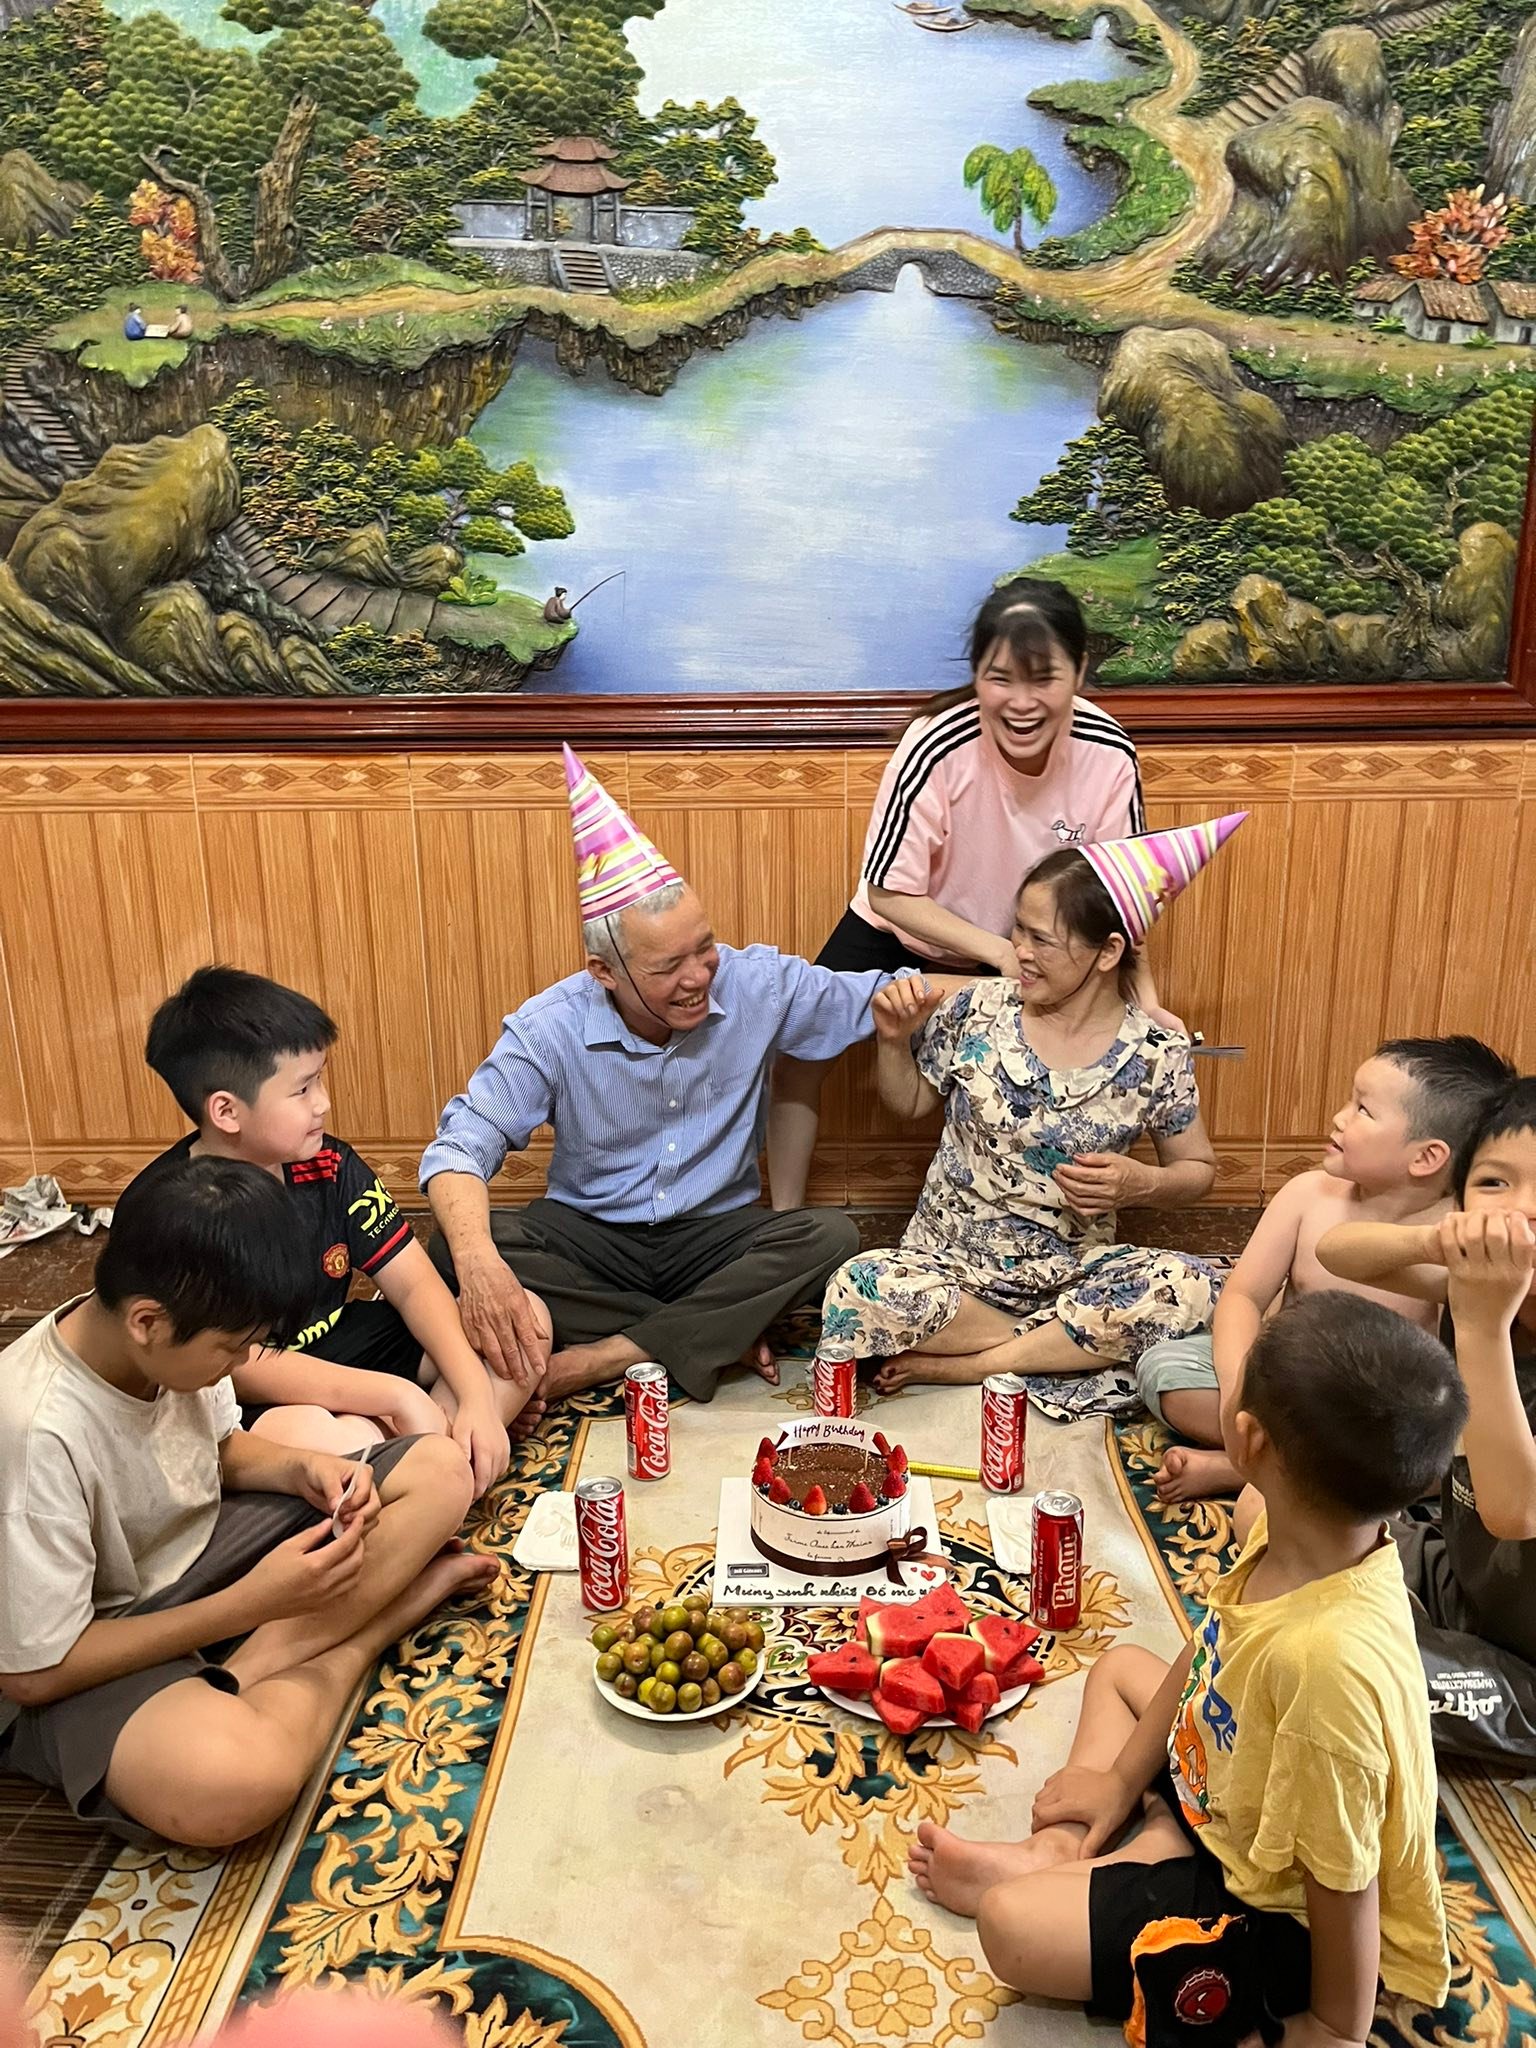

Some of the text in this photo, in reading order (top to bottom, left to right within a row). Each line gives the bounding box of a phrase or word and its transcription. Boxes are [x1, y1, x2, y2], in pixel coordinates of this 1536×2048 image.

[348, 1177, 392, 1231] DX
[368, 1204, 399, 1239] TECHNO
[794, 1424, 865, 1442] Happy Birthday
[580, 1499, 623, 1612] Coca-Cola
